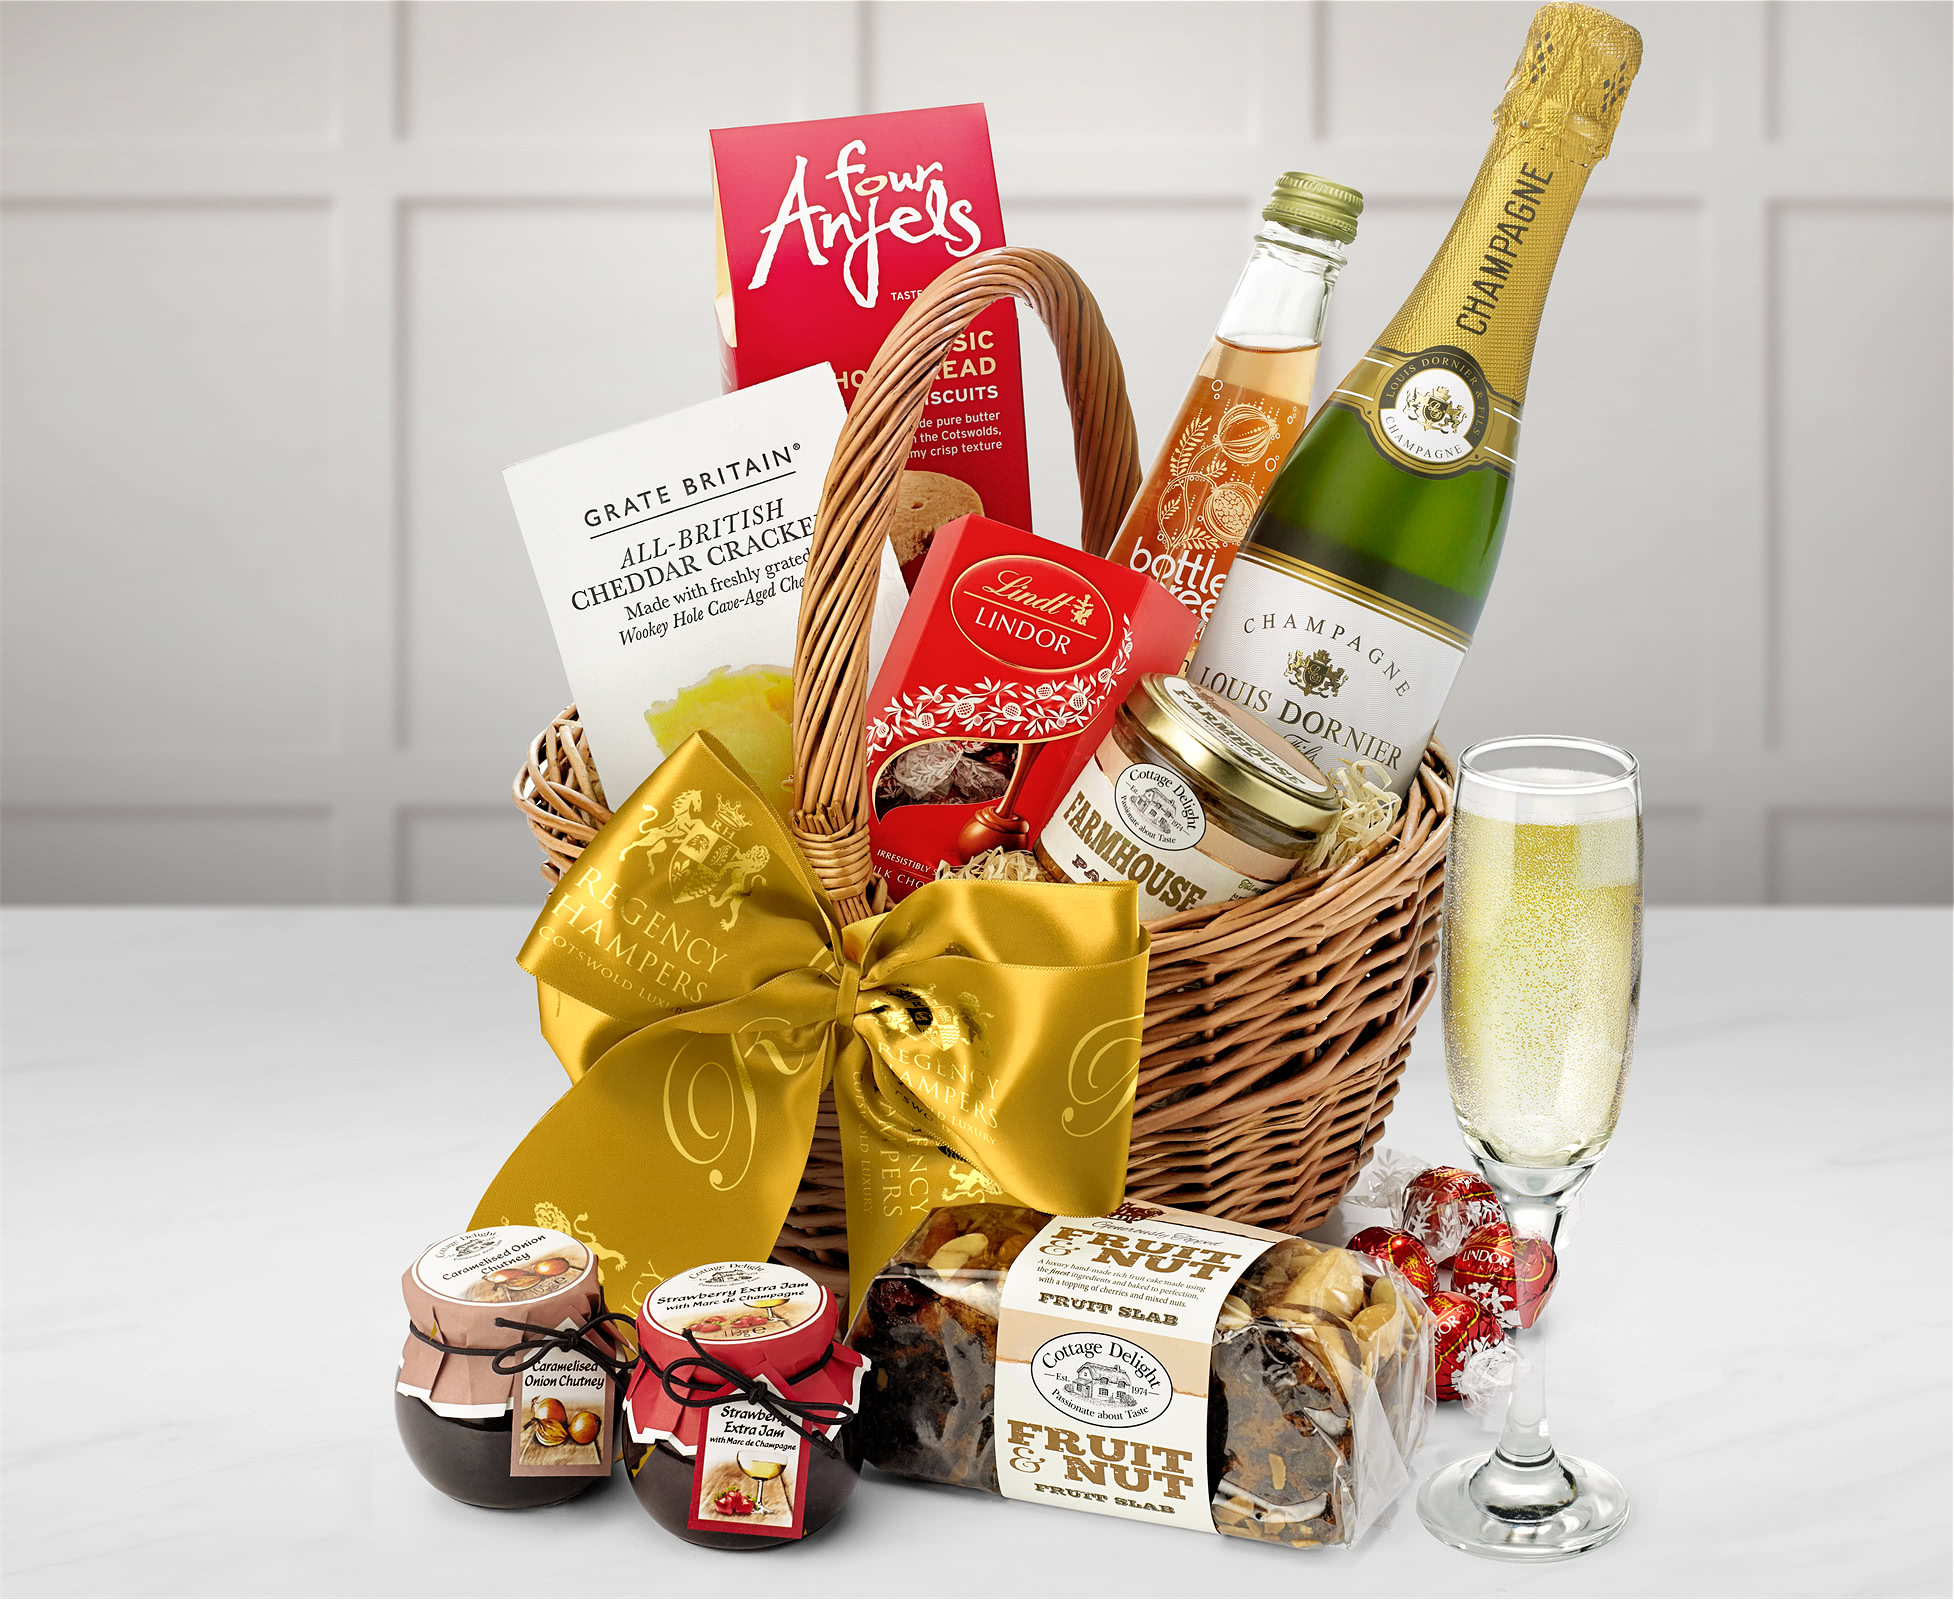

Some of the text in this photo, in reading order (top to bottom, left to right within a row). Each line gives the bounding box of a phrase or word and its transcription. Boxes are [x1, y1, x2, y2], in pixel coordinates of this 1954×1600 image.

[825, 139, 943, 222] four
[1456, 161, 1553, 336] CHAMPAGNE
[924, 385, 999, 406] ISCUITS
[1386, 356, 1486, 436] LOUIS DORNIER & FILS
[920, 430, 939, 443] the
[941, 425, 1002, 441] Cotswolds,
[936, 415, 962, 428] pure
[965, 411, 1001, 424] butter
[1385, 416, 1463, 459] CHAMPAGNE
[930, 445, 958, 459] crisp
[961, 440, 1003, 453] texture
[584, 485, 671, 527] GRATE
[620, 498, 784, 570] ALL-BRITISH
[571, 514, 818, 611] CHEDDAR CRACKE
[1130, 536, 1228, 598] bottle
[624, 547, 811, 621] Made with freshly grated
[982, 570, 1073, 616] Lindt
[619, 621, 669, 646] Wookey
[673, 607, 705, 629] Hole
[707, 583, 777, 616] Cave-Aged
[975, 606, 1071, 655] LINDOR
[1244, 613, 1411, 697] CHAMPAGNE
[1200, 666, 1273, 713] LOUIS
[1277, 698, 1402, 771] DORNIER
[1120, 794, 1176, 844] Passionate about Taste
[1129, 768, 1199, 830] Cottage Delight
[872, 864, 893, 879] ILK
[877, 848, 931, 873] IRRESISTIBLY
[1062, 790, 1208, 913] FARMHOUSE
[575, 865, 728, 975] REGENCY
[539, 926, 633, 990] COTSWOLD
[551, 892, 708, 1003] HAMPERS
[888, 1065, 998, 1129] AMPERS
[951, 1117, 996, 1146] LUXURY
[442, 1249, 512, 1281] Caramelised
[511, 1234, 547, 1252] Onion
[480, 1251, 531, 1276] Chutney
[1039, 1239, 1231, 1281] & NUT
[1050, 1226, 1242, 1265] FRUIT
[1462, 1249, 1511, 1268] LINDOR
[656, 1281, 809, 1305] Strawberry Extra Jam
[1038, 1275, 1055, 1285] with
[1061, 1280, 1089, 1292] topping
[1090, 1284, 1100, 1293] of
[1099, 1286, 1129, 1298] cherries
[1129, 1291, 1144, 1300] and
[1144, 1294, 1169, 1305] mixed
[1169, 1299, 1187, 1308] nuts.
[1045, 1259, 1071, 1270] luxury
[1112, 1270, 1128, 1279] rich
[1128, 1273, 1145, 1283] fruit
[1146, 1276, 1165, 1285] cake
[1165, 1280, 1185, 1289] made
[1185, 1284, 1207, 1293] using
[1049, 1267, 1071, 1277] finest
[1070, 1270, 1112, 1285] ingredients
[1112, 1278, 1127, 1286] and
[1127, 1280, 1150, 1290] baked
[1159, 1286, 1200, 1300] perfection,
[666, 1302, 690, 1311] with
[692, 1299, 720, 1308] Marc
[738, 1290, 805, 1302] Champagne
[1038, 1291, 1179, 1326] FRUIT SLAB
[524, 1374, 605, 1390] Onion Chutney
[532, 1359, 599, 1372] Caramelised
[1042, 1341, 1161, 1389] Cottage Delight
[1056, 1372, 1149, 1396] Est. 1974
[1050, 1387, 1150, 1421] Passionate about Taste
[709, 1435, 797, 1452] with Marc de Champagne
[723, 1421, 786, 1438] Extra Jam
[1007, 1418, 1193, 1475] FRUIT
[1009, 1446, 1194, 1501] & NUT
[1034, 1482, 1176, 1515] FRUIT SLAB
